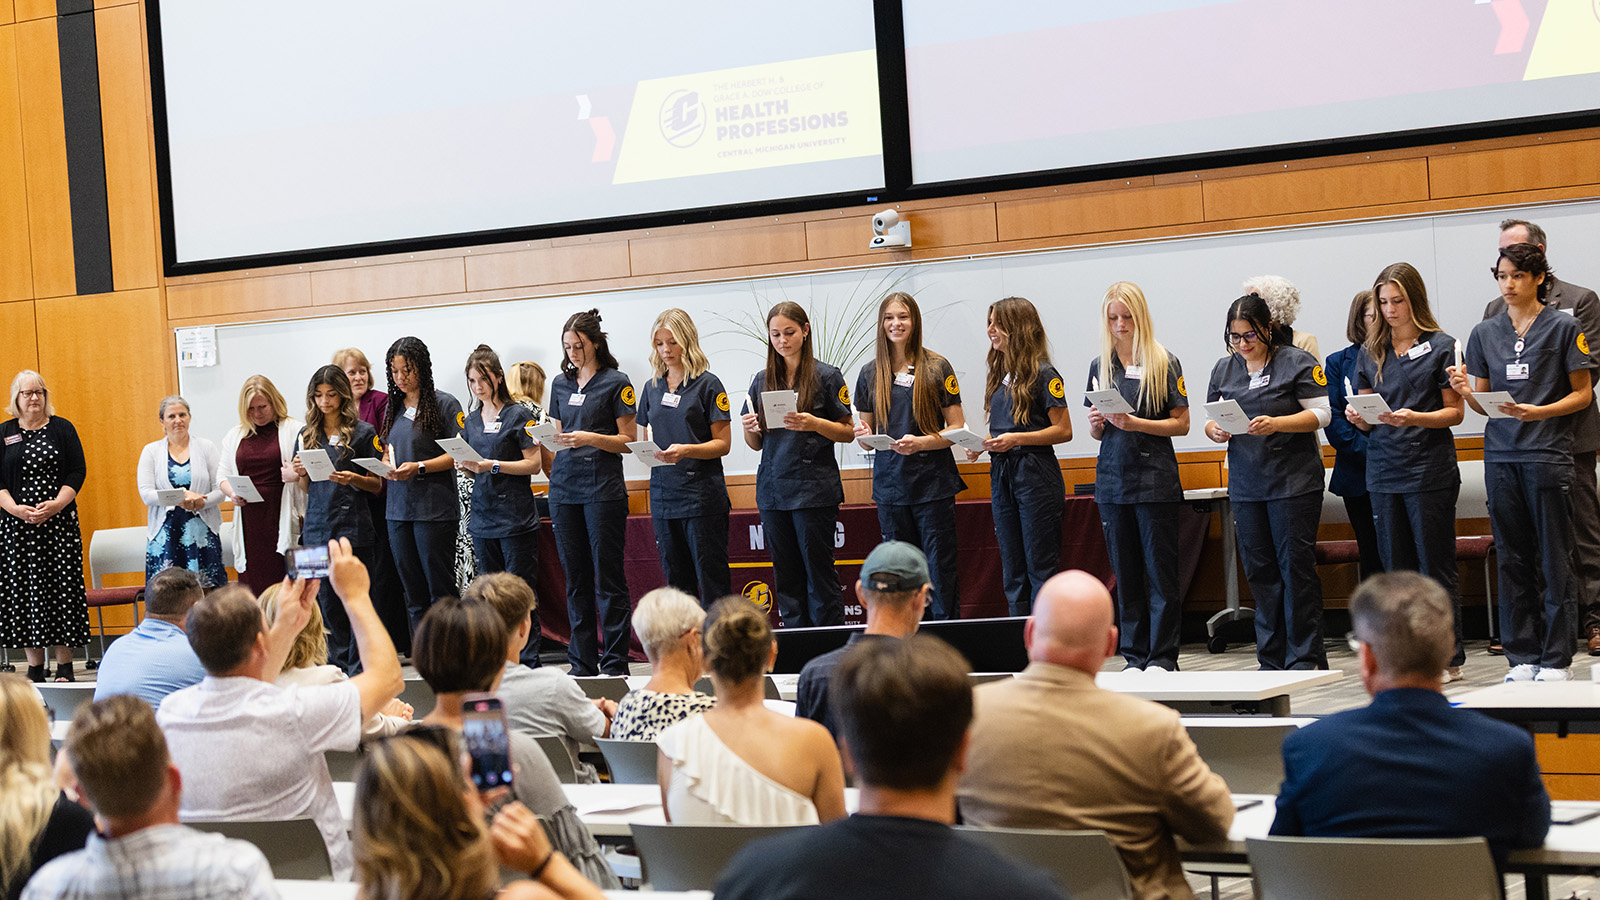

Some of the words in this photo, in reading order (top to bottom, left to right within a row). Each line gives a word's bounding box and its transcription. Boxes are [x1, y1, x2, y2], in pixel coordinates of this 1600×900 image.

[713, 83, 729, 92] THE
[730, 77, 767, 90] HERBERT
[768, 76, 776, 85] H.
[779, 75, 785, 83] &
[713, 92, 741, 102] GRACE
[742, 90, 750, 99] A.
[752, 88, 772, 98] DOW
[774, 83, 812, 95] COLLEGE
[813, 80, 825, 90] OF
[715, 99, 789, 122] HEALTH
[716, 111, 849, 141] PROFESSIONS
[717, 148, 754, 158] CENTRAL
[755, 142, 796, 155] MICHIGAN
[797, 136, 847, 149] UNIVERSITY
